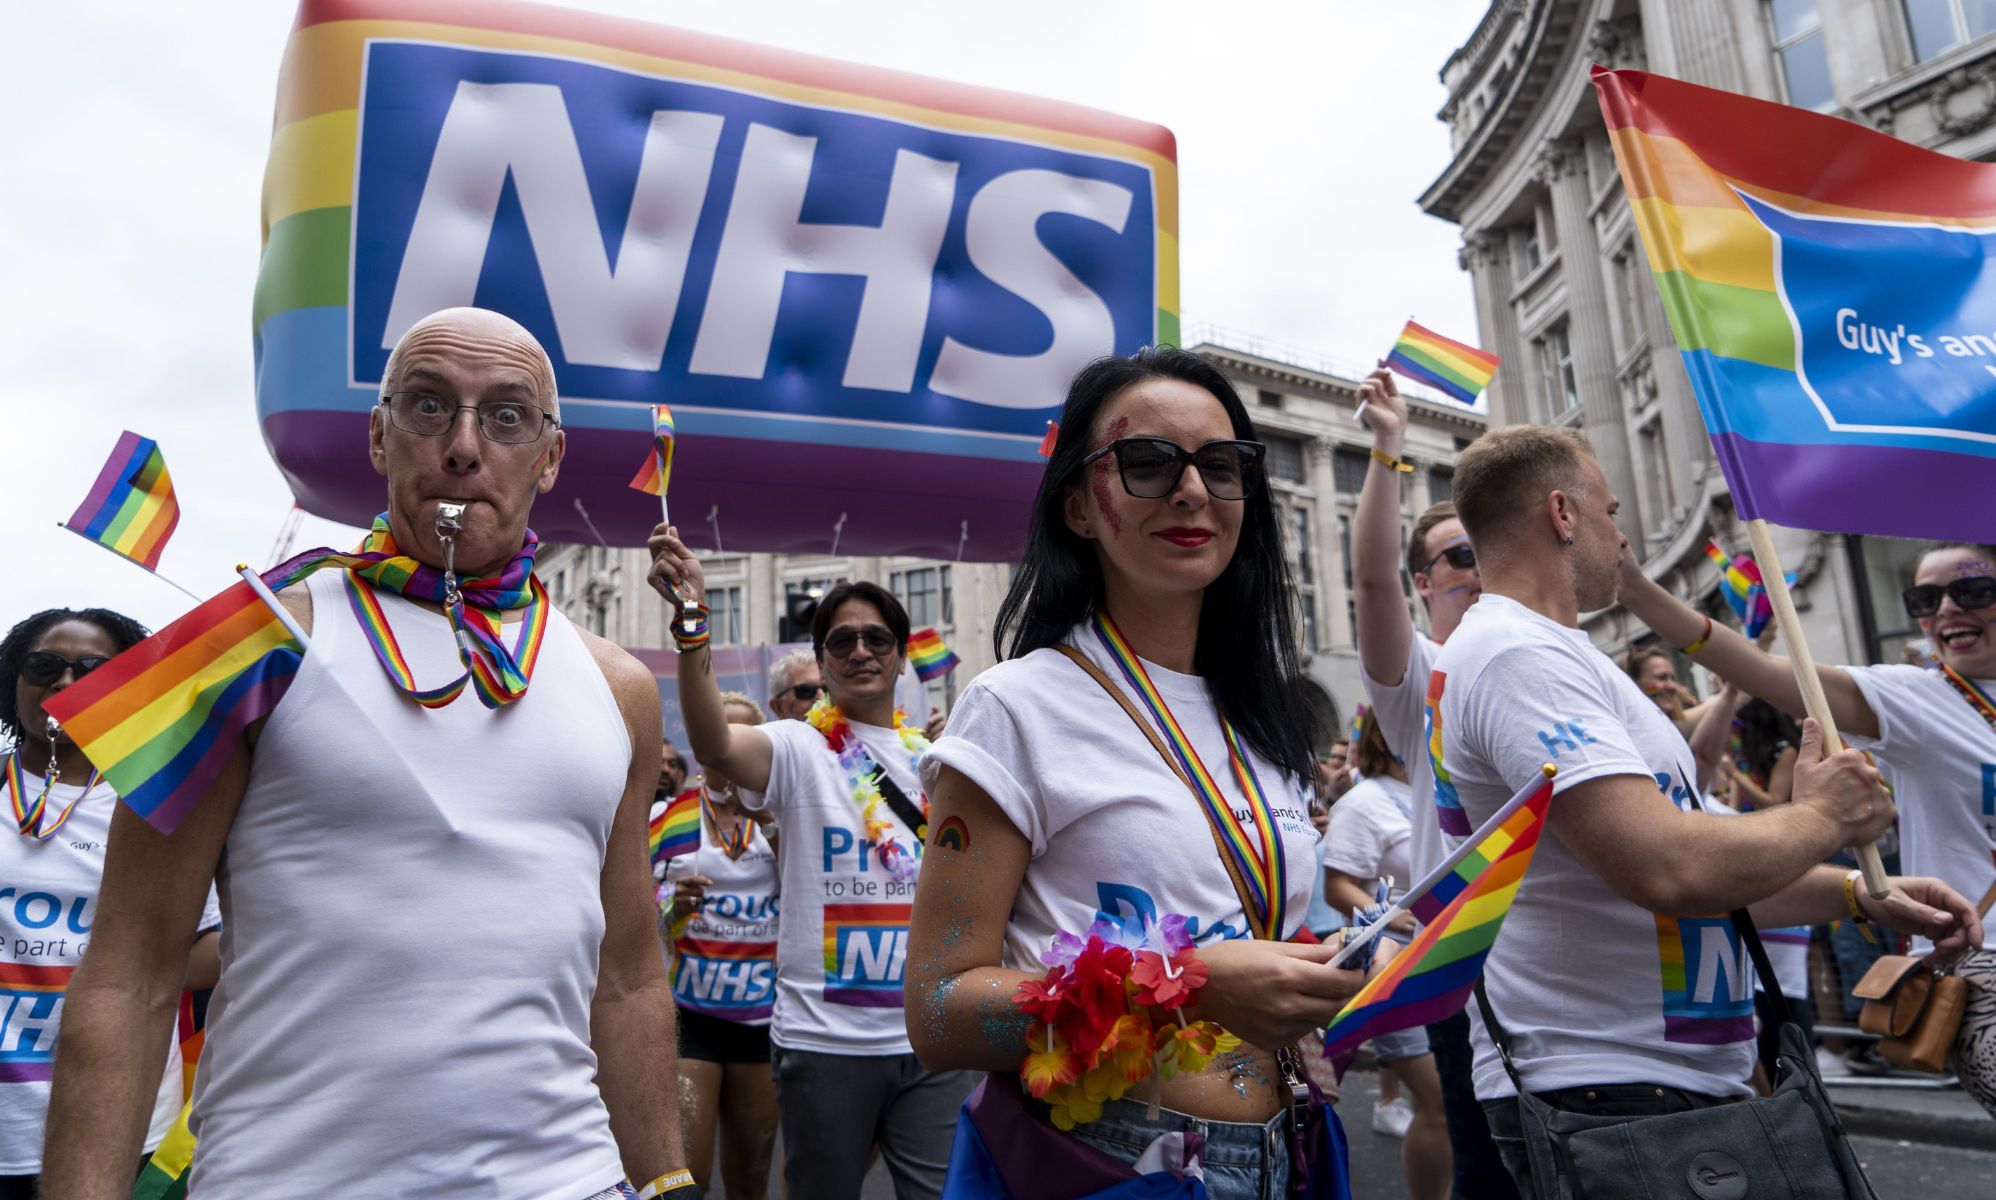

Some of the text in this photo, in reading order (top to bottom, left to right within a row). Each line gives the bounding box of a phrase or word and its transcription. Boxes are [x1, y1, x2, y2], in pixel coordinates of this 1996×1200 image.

[381, 80, 1134, 409] NHS
[1836, 308, 1935, 365] Guy's
[1272, 806, 1295, 819] and
[70, 841, 100, 851] Guy's
[824, 880, 845, 896] to
[853, 876, 877, 896] be
[714, 922, 747, 938] part
[14, 938, 67, 959] part
[677, 957, 772, 1001] NHS
[663, 1172, 693, 1188] RADE
